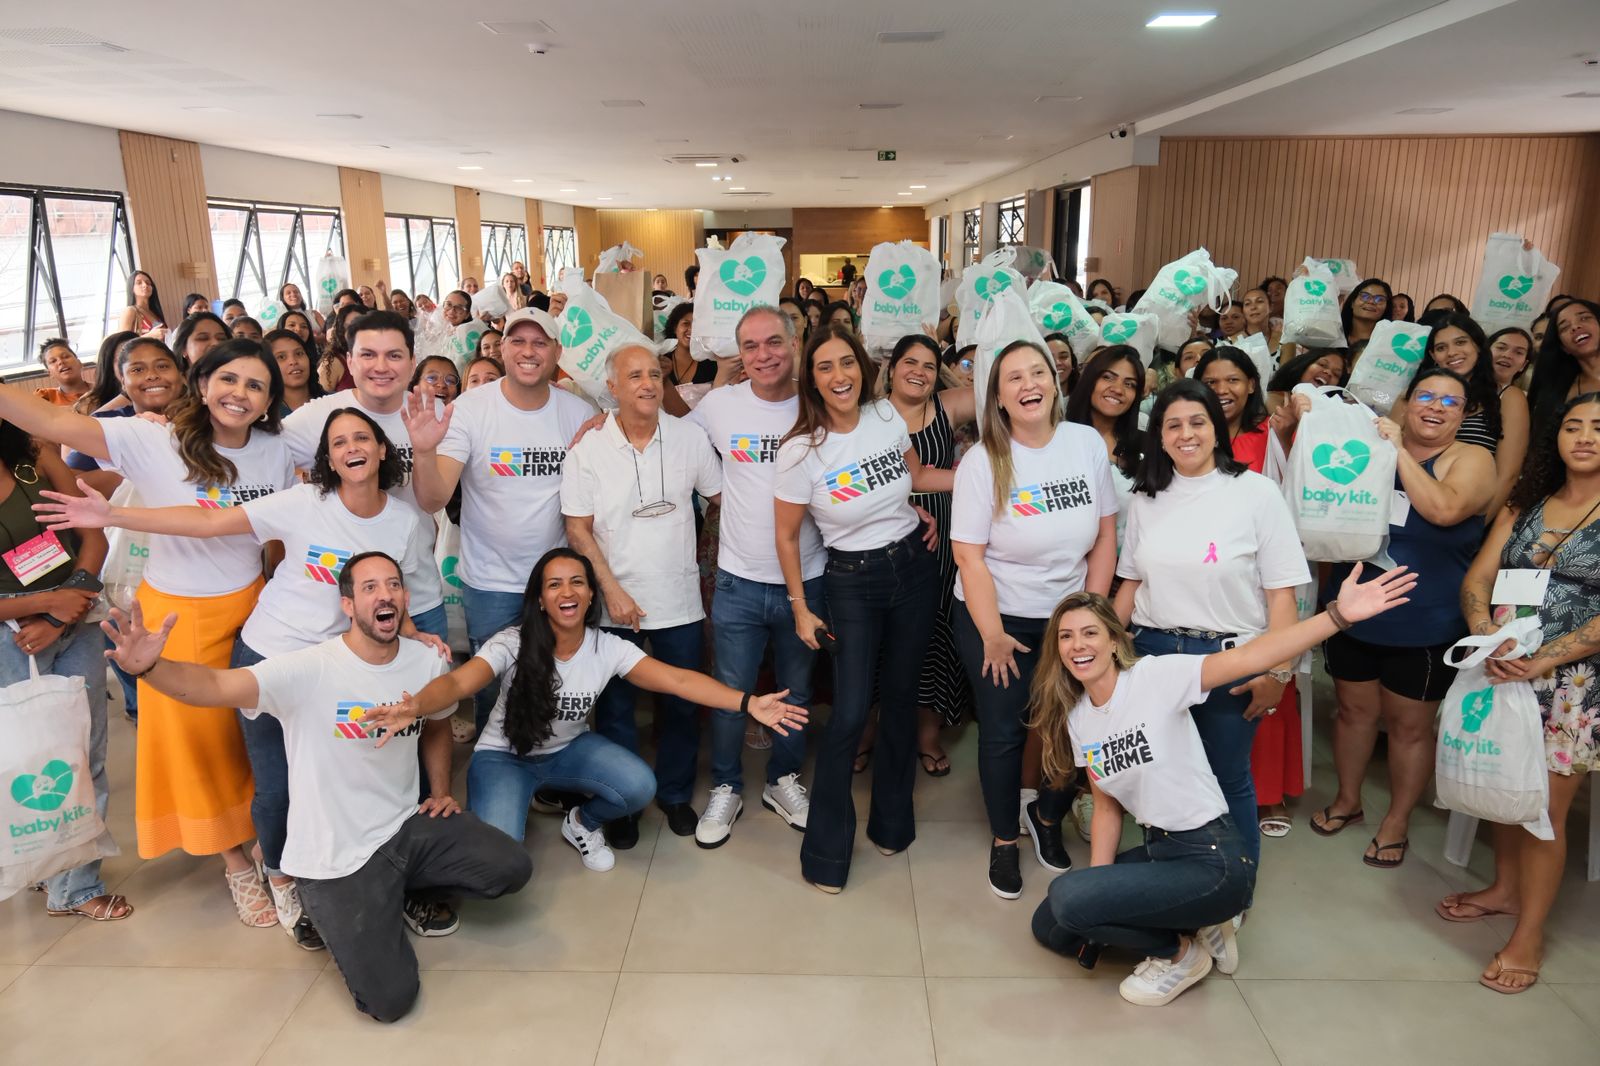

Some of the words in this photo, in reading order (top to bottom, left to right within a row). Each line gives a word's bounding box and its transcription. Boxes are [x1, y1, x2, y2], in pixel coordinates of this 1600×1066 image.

[713, 298, 749, 314] baby
[874, 301, 900, 316] baby
[1489, 299, 1515, 311] baby
[576, 340, 606, 371] baby
[1375, 358, 1406, 376] baby
[523, 451, 566, 463] TERRA
[523, 464, 563, 476] FIRM
[866, 460, 909, 491] FIRM
[1042, 479, 1089, 499] TERRA
[1302, 486, 1347, 506] baby
[1046, 491, 1093, 512] FIRME
[130, 543, 149, 558] ba
[561, 696, 597, 710] ERR
[1102, 730, 1148, 759] TERRA
[1104, 745, 1154, 776] FIRME
[9, 817, 61, 838] baby
